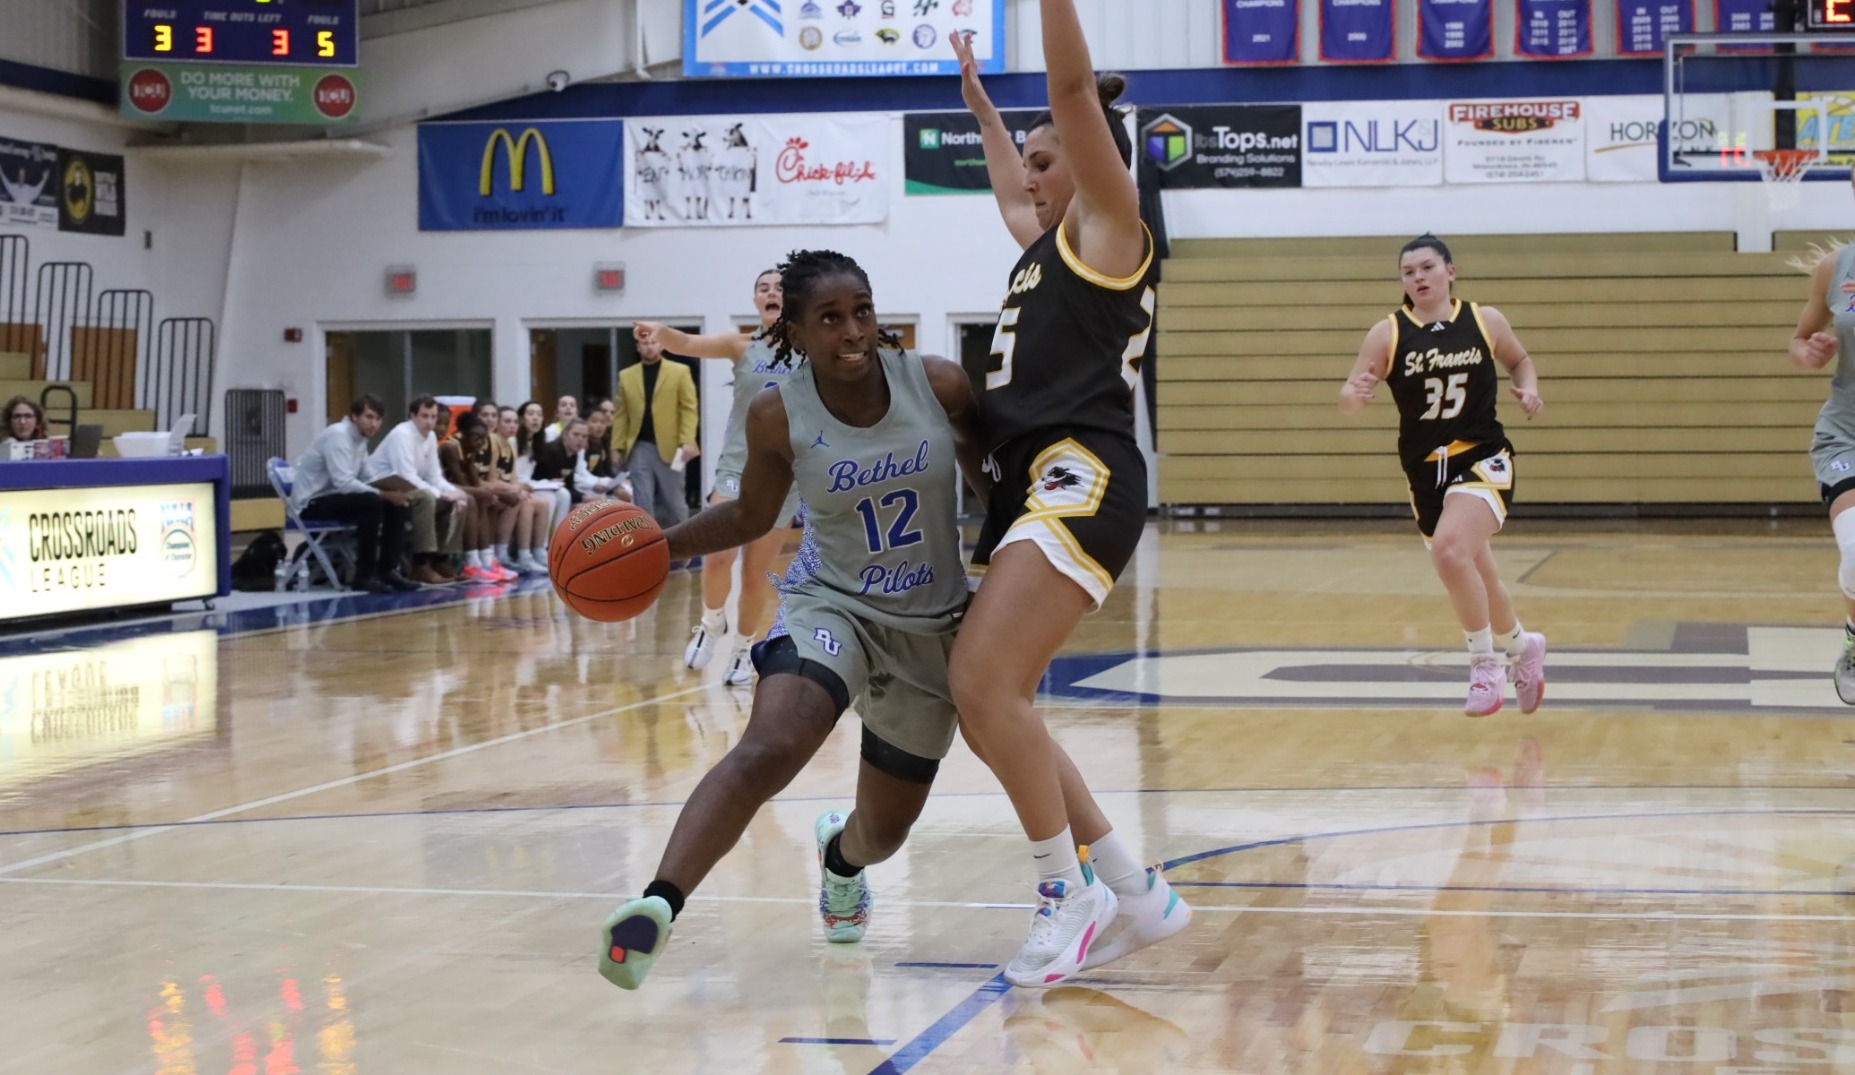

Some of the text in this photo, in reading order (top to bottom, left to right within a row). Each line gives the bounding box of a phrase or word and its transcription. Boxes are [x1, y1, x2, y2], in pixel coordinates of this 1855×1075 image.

[154, 25, 172, 51] 3
[195, 27, 213, 53] 3
[271, 29, 289, 55] 3
[318, 31, 335, 57] 5
[181, 72, 300, 88] DO MORE WITH
[749, 62, 939, 75] WWW.CROSSROADSLEAGUE.COM
[188, 86, 294, 102] YOUR MONEY.
[1452, 103, 1577, 125] FIREHOUSE
[1493, 117, 1538, 130] SUBS
[776, 146, 876, 185] Chick-fil-A
[1196, 153, 1295, 165] Branding Solutions
[1426, 346, 1483, 372] Francis
[1419, 372, 1469, 421] 35
[827, 439, 929, 493] Bethel
[854, 487, 924, 555] 12
[30, 508, 138, 562] CROSSROADS
[31, 563, 106, 593] LEAGUE
[858, 560, 934, 597] Pilots
